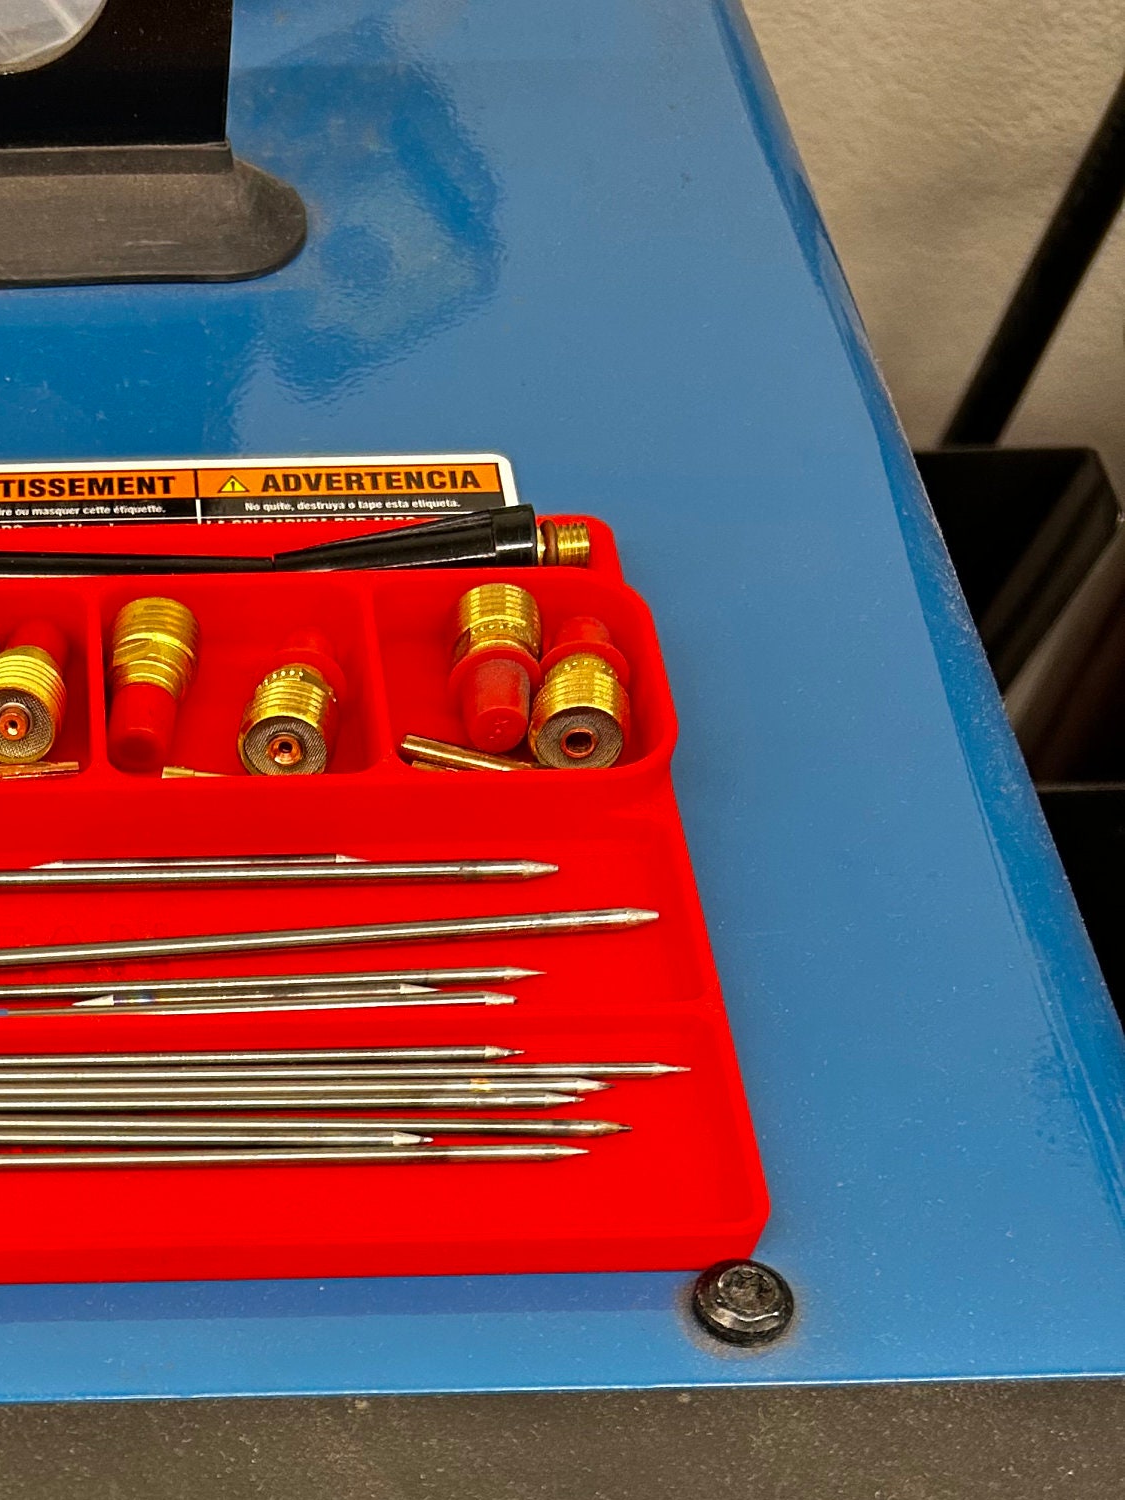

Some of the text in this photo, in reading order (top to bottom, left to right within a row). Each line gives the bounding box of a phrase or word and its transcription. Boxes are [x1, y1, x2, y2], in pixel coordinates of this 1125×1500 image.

[261, 470, 482, 492] ADVERTENCIA
[14, 507, 30, 516] ou
[31, 506, 80, 517] masquer
[82, 505, 111, 516] cette
[113, 504, 166, 516] étiquette.
[245, 502, 260, 512] No
[262, 500, 295, 513] quite,
[297, 500, 345, 513] destruya
[357, 500, 383, 511] tape
[385, 499, 410, 510] esta
[412, 498, 461, 511] etiqueta.
